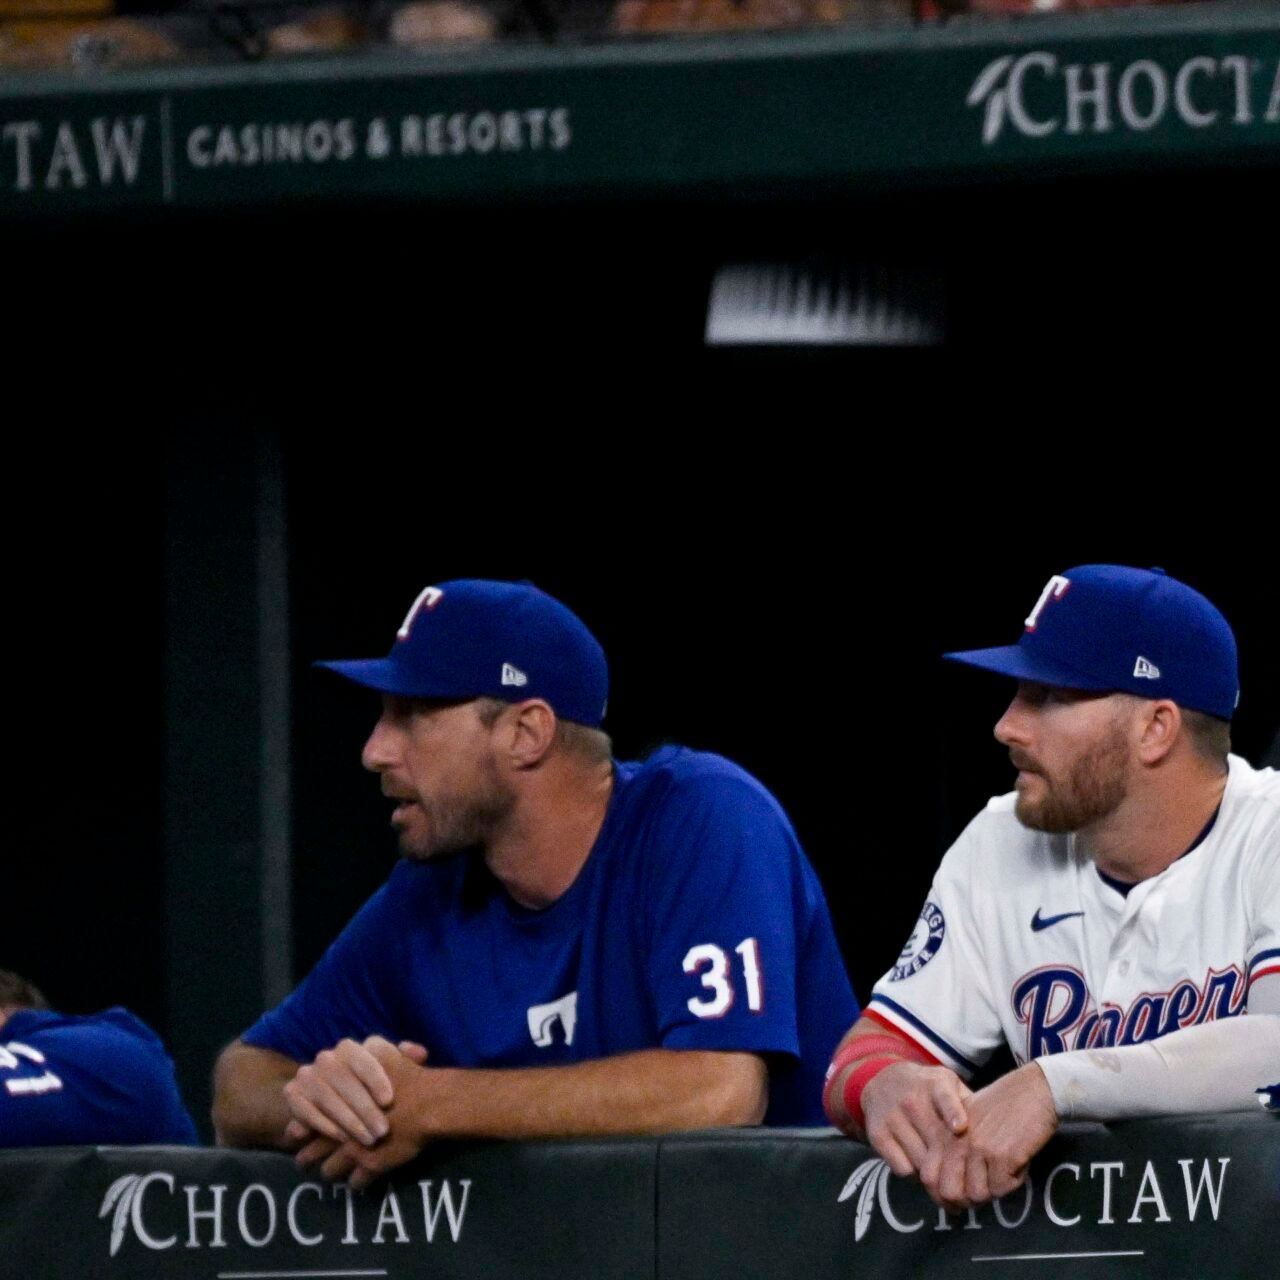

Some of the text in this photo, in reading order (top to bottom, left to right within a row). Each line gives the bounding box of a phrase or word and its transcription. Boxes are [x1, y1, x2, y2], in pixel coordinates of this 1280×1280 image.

[186, 118, 356, 168] CASINOS
[366, 118, 391, 158] &
[400, 107, 572, 156] RESORTS
[682, 936, 763, 1020] 31
[131, 1172, 472, 1249] CHOCTAW
